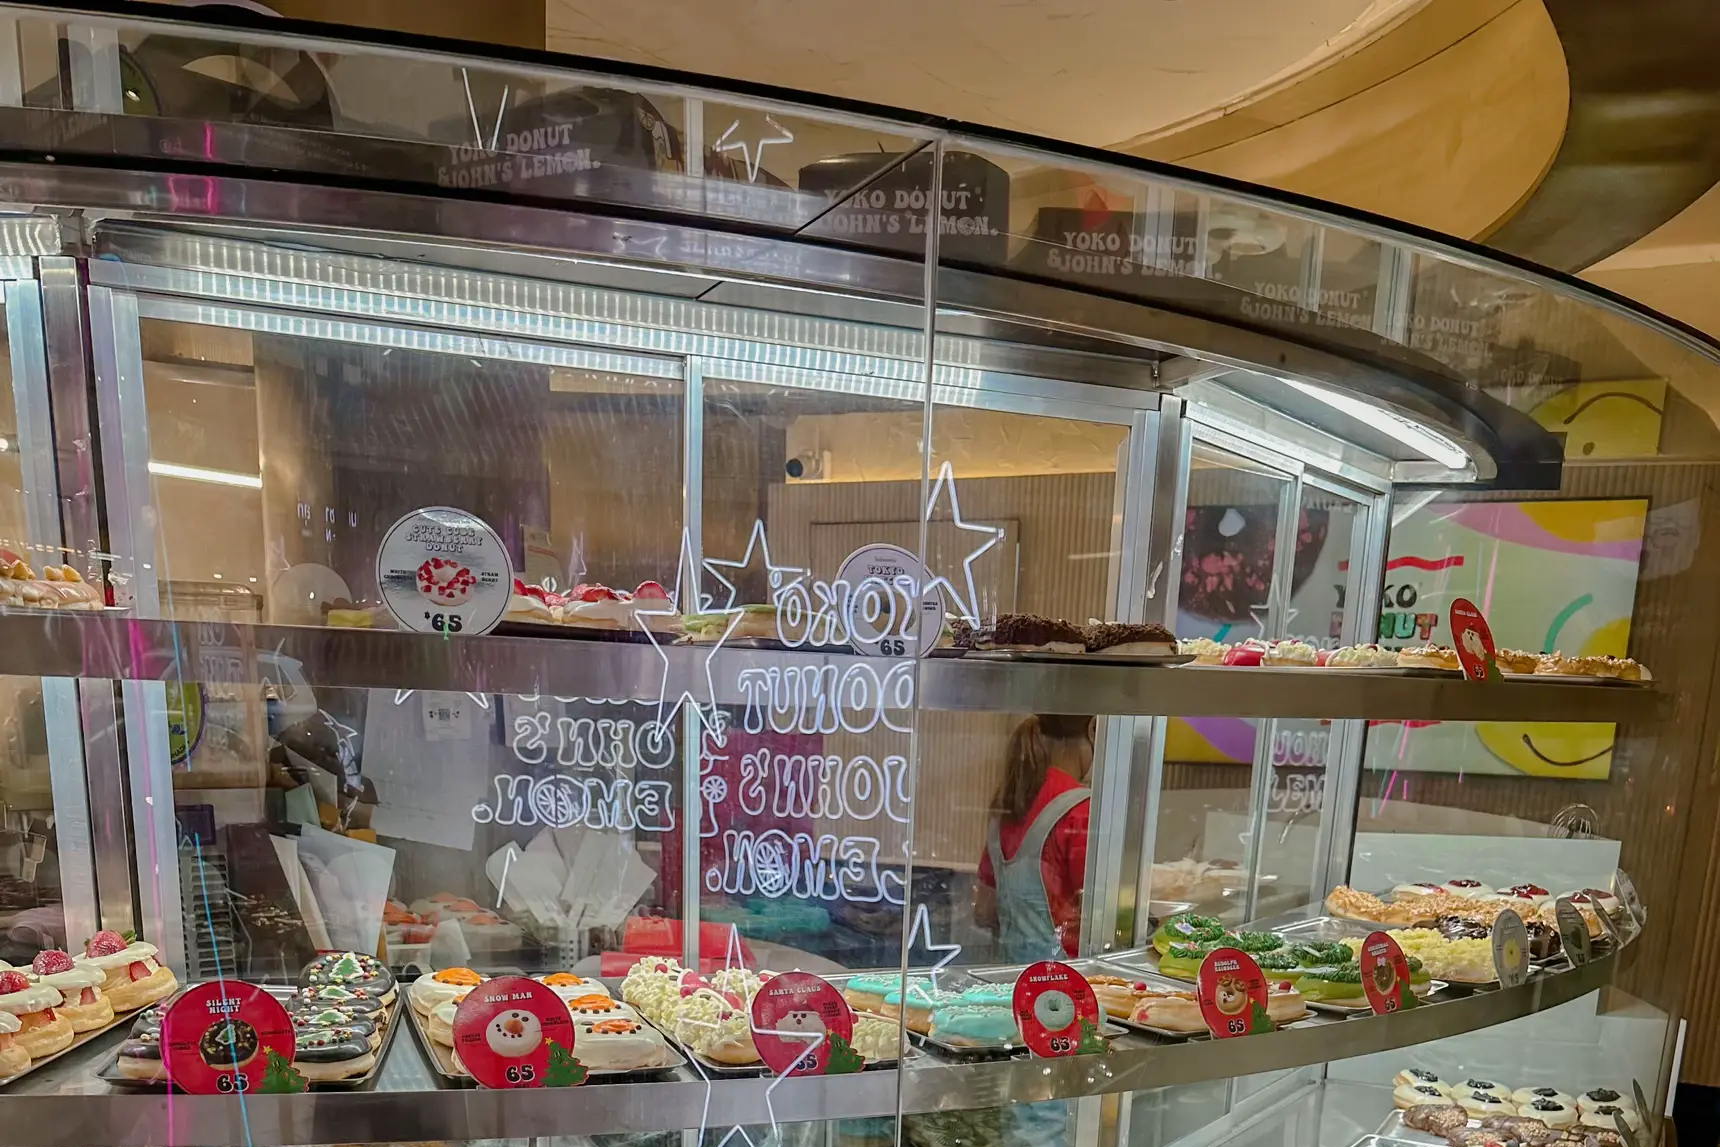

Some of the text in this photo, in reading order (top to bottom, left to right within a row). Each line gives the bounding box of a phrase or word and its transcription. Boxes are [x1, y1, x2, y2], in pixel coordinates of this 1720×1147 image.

[505, 123, 573, 152] DONUT
[824, 188, 886, 209] YOKO
[1063, 231, 1198, 254] YOKO DONUT
[1253, 281, 1301, 301] YOKO
[425, 541, 465, 553] DONUT
[867, 564, 905, 576] TOKYO
[1029, 973, 1069, 983] SNOWFLAKE
[484, 991, 533, 1004] SNOW MAN
[769, 984, 822, 997] SANTA CLAUS
[205, 997, 242, 1008] SILENT
[209, 1004, 241, 1014] NIGHT
[1227, 1017, 1246, 1034] 65
[505, 1063, 536, 1084] 65
[216, 1072, 249, 1094] 65
